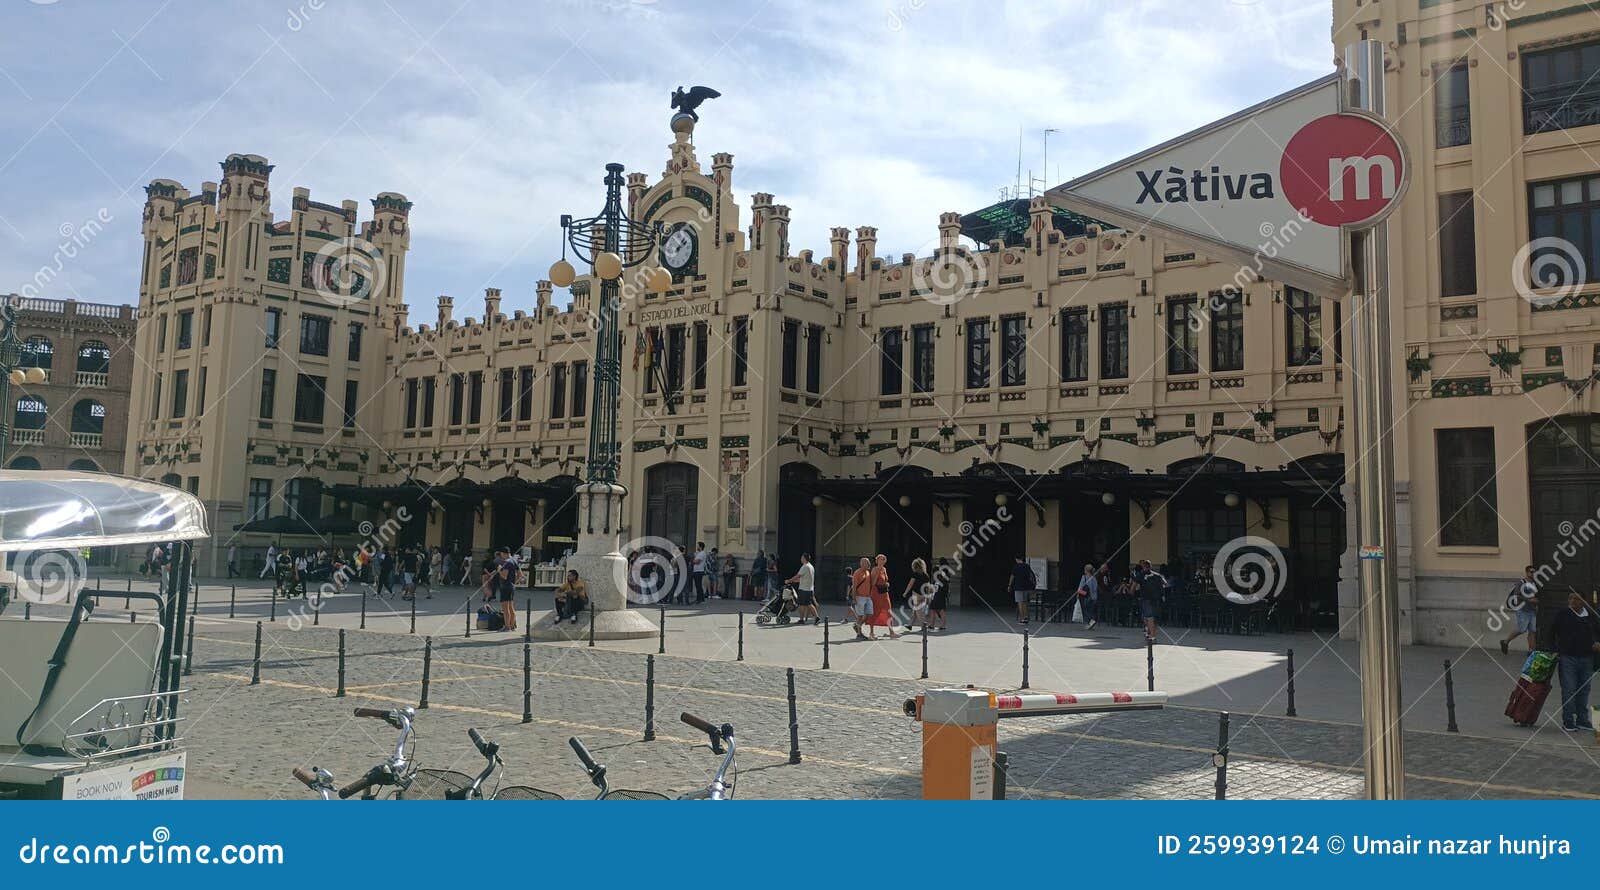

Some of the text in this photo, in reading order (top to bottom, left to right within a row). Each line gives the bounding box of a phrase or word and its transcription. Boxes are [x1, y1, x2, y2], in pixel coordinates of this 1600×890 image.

[1135, 166, 1274, 205] Xàtiva
[1328, 154, 1396, 202] m
[674, 306, 690, 318] DEL
[77, 781, 123, 799] BOOK NOW
[136, 784, 179, 800] TOURISM HUB
